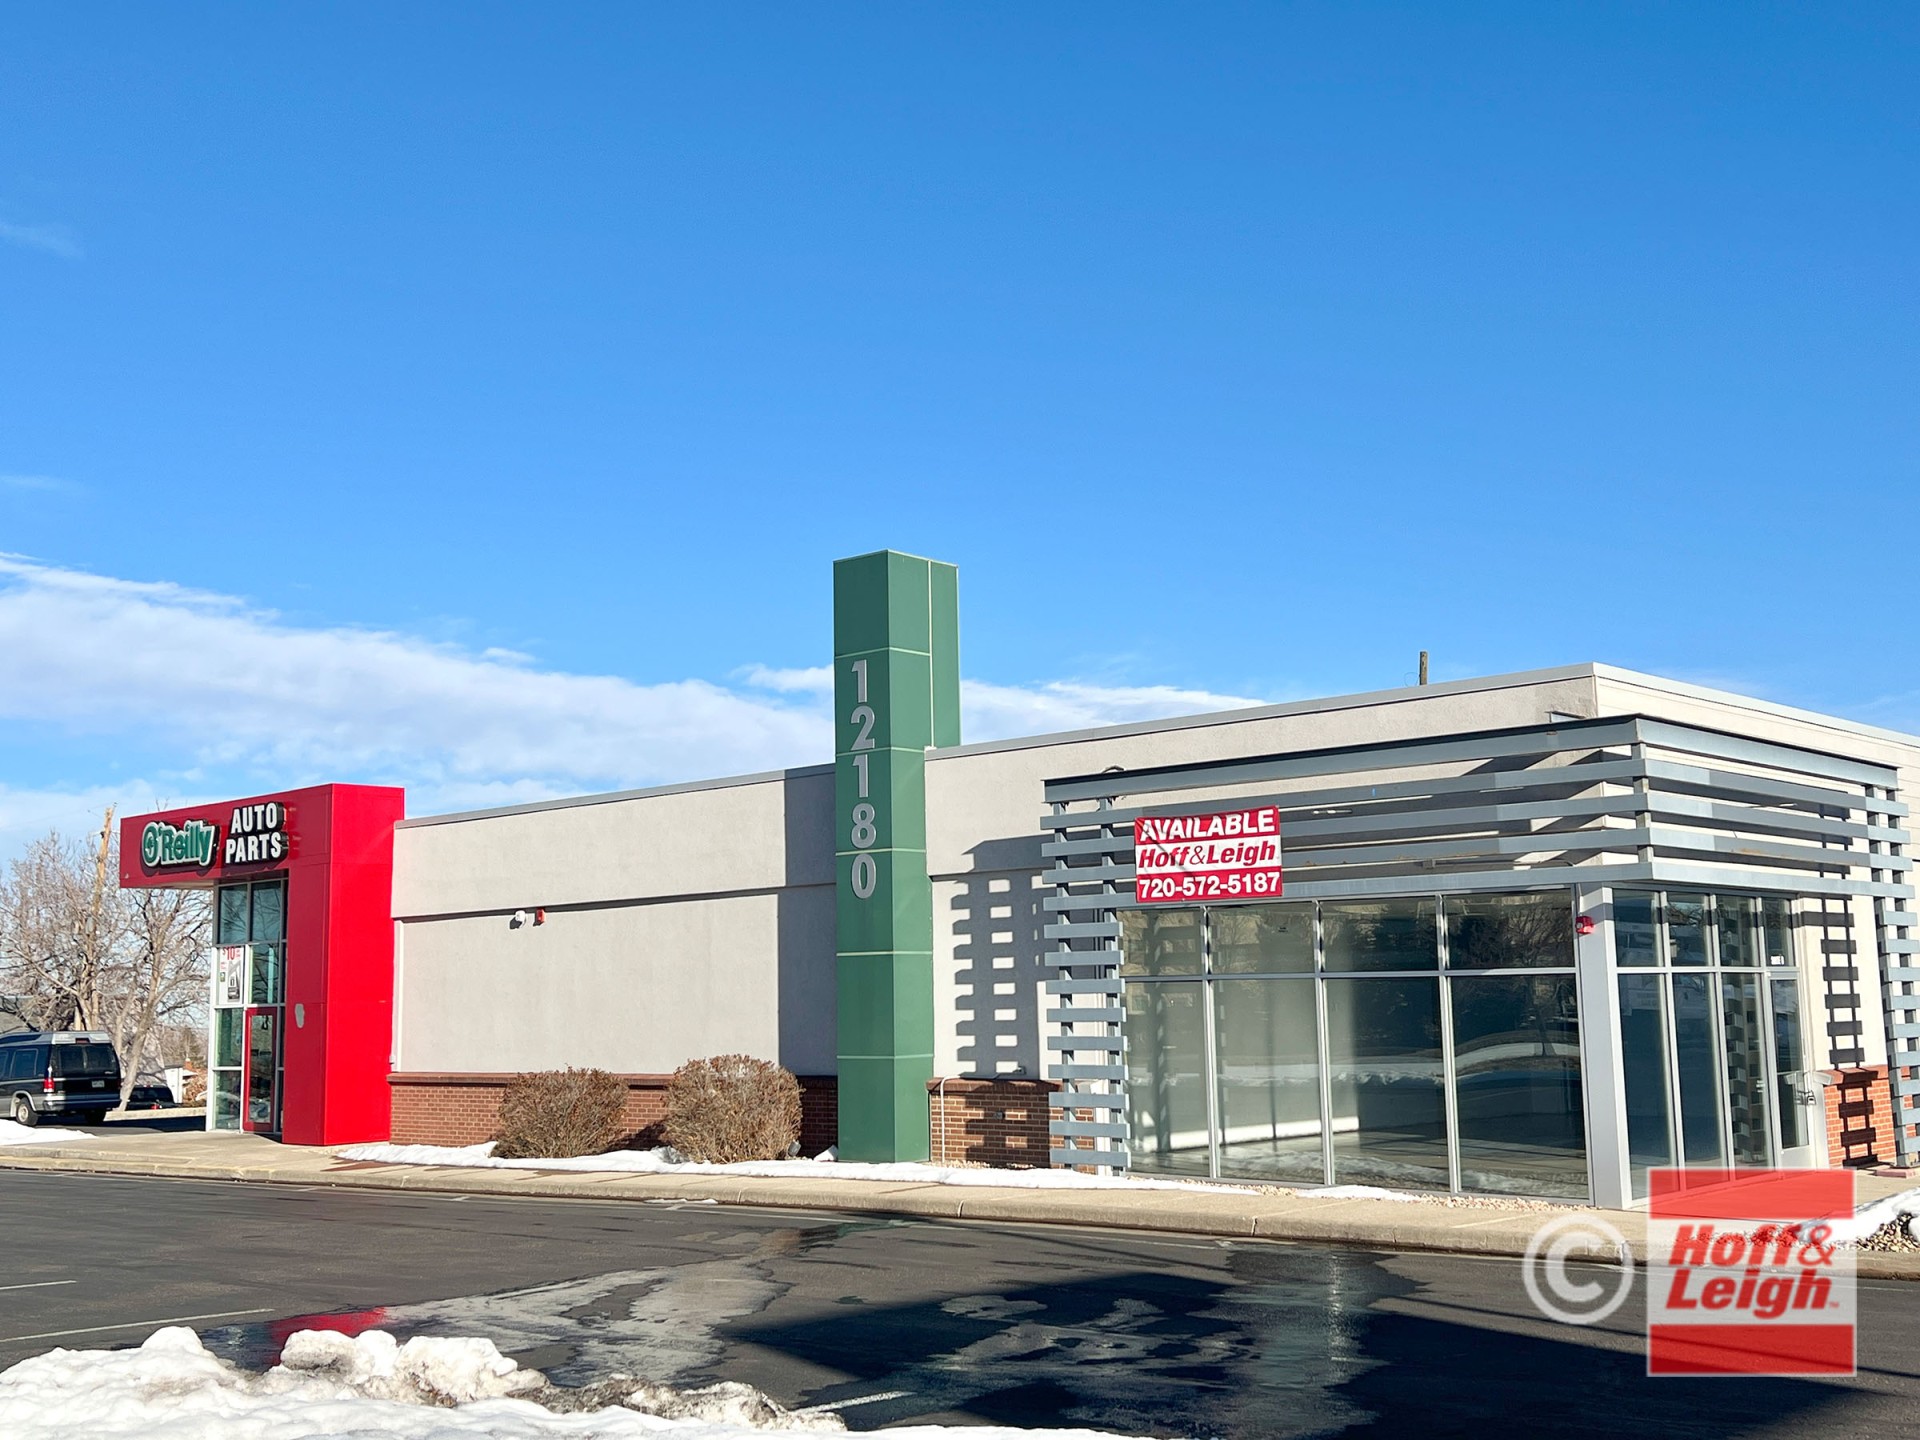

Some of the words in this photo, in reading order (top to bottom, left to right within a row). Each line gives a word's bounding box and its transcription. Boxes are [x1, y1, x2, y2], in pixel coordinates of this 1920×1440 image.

[850, 659, 877, 899] 12180
[230, 802, 278, 834] AUTO
[1139, 808, 1275, 842] AVAILABLE
[142, 820, 215, 867] O'Reilly
[225, 832, 283, 864] PARTS
[1138, 840, 1276, 869] Hoff&Leigh
[1139, 871, 1280, 899] 720-572-5187
